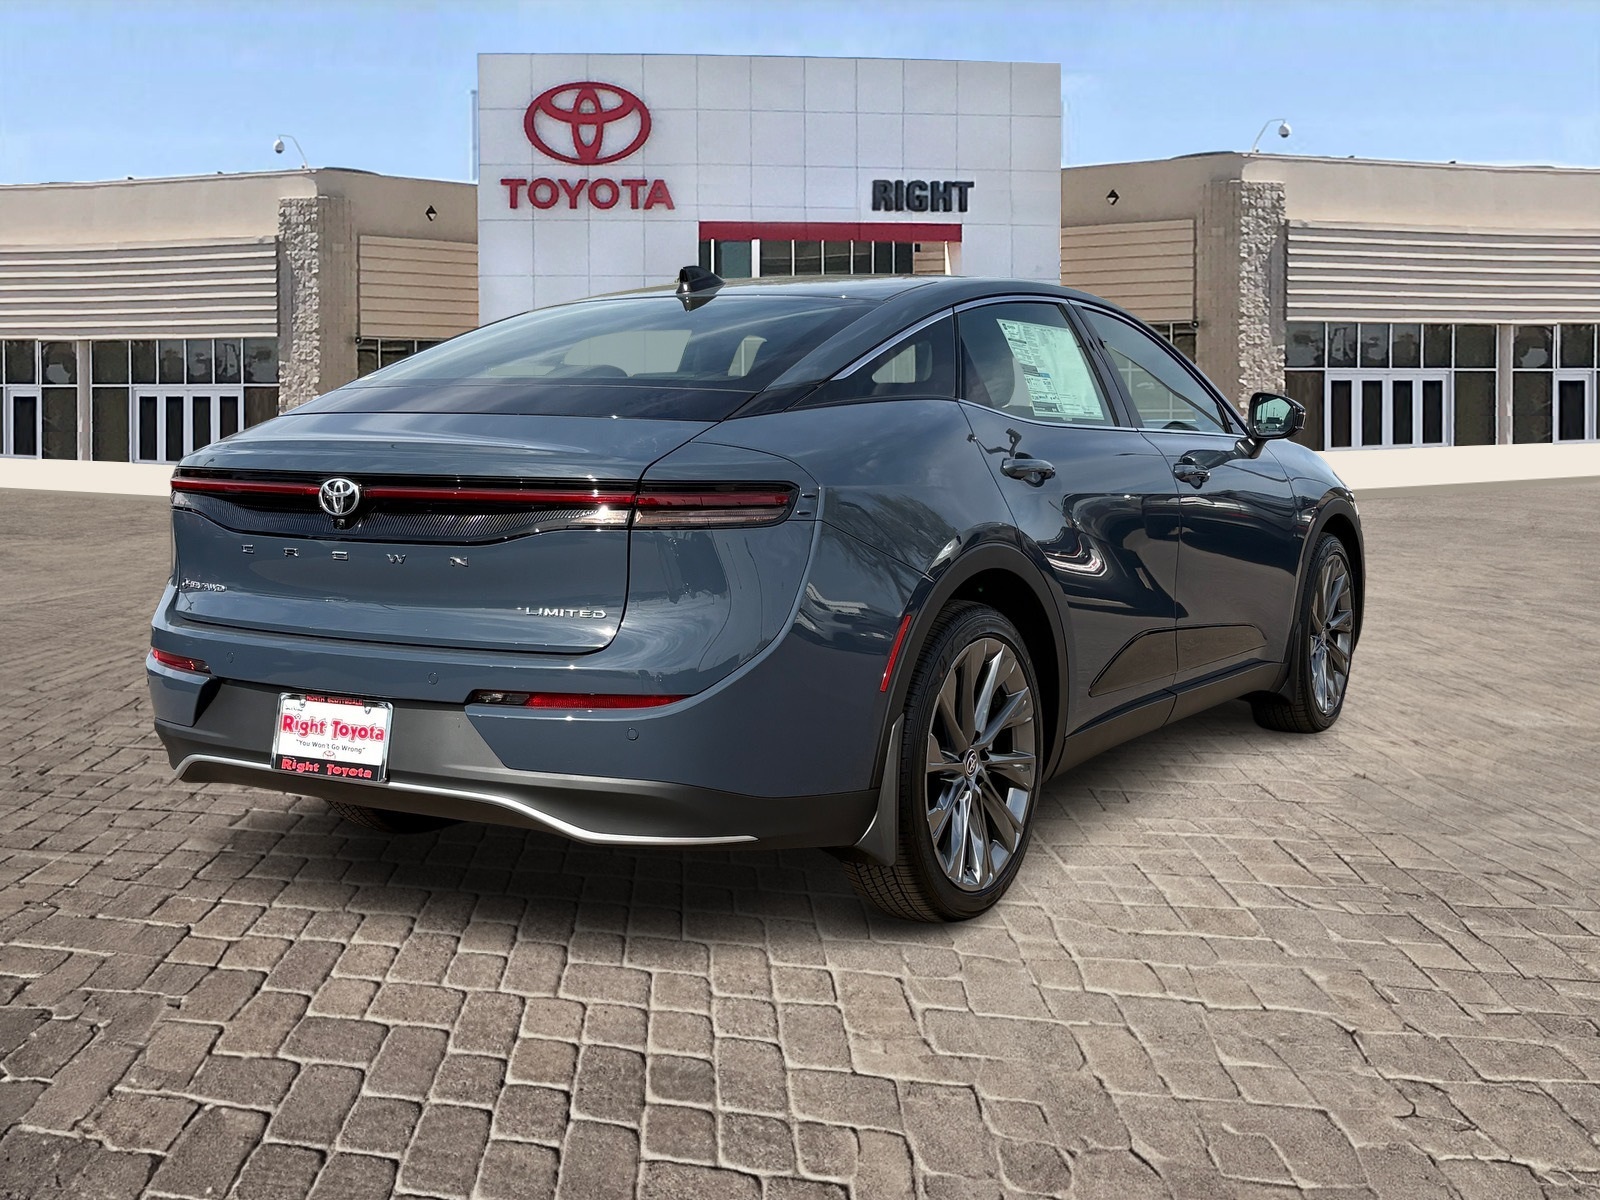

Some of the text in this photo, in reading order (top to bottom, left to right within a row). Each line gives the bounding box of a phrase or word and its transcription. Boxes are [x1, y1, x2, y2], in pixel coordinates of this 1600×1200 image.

[500, 178, 675, 211] TOYOTA
[871, 179, 975, 213] RIGHT
[525, 606, 607, 618] LIMITED
[282, 714, 386, 741] Right Toyota
[312, 741, 330, 749] Won't
[331, 743, 340, 751] Go
[281, 758, 372, 778] Right Toyota
